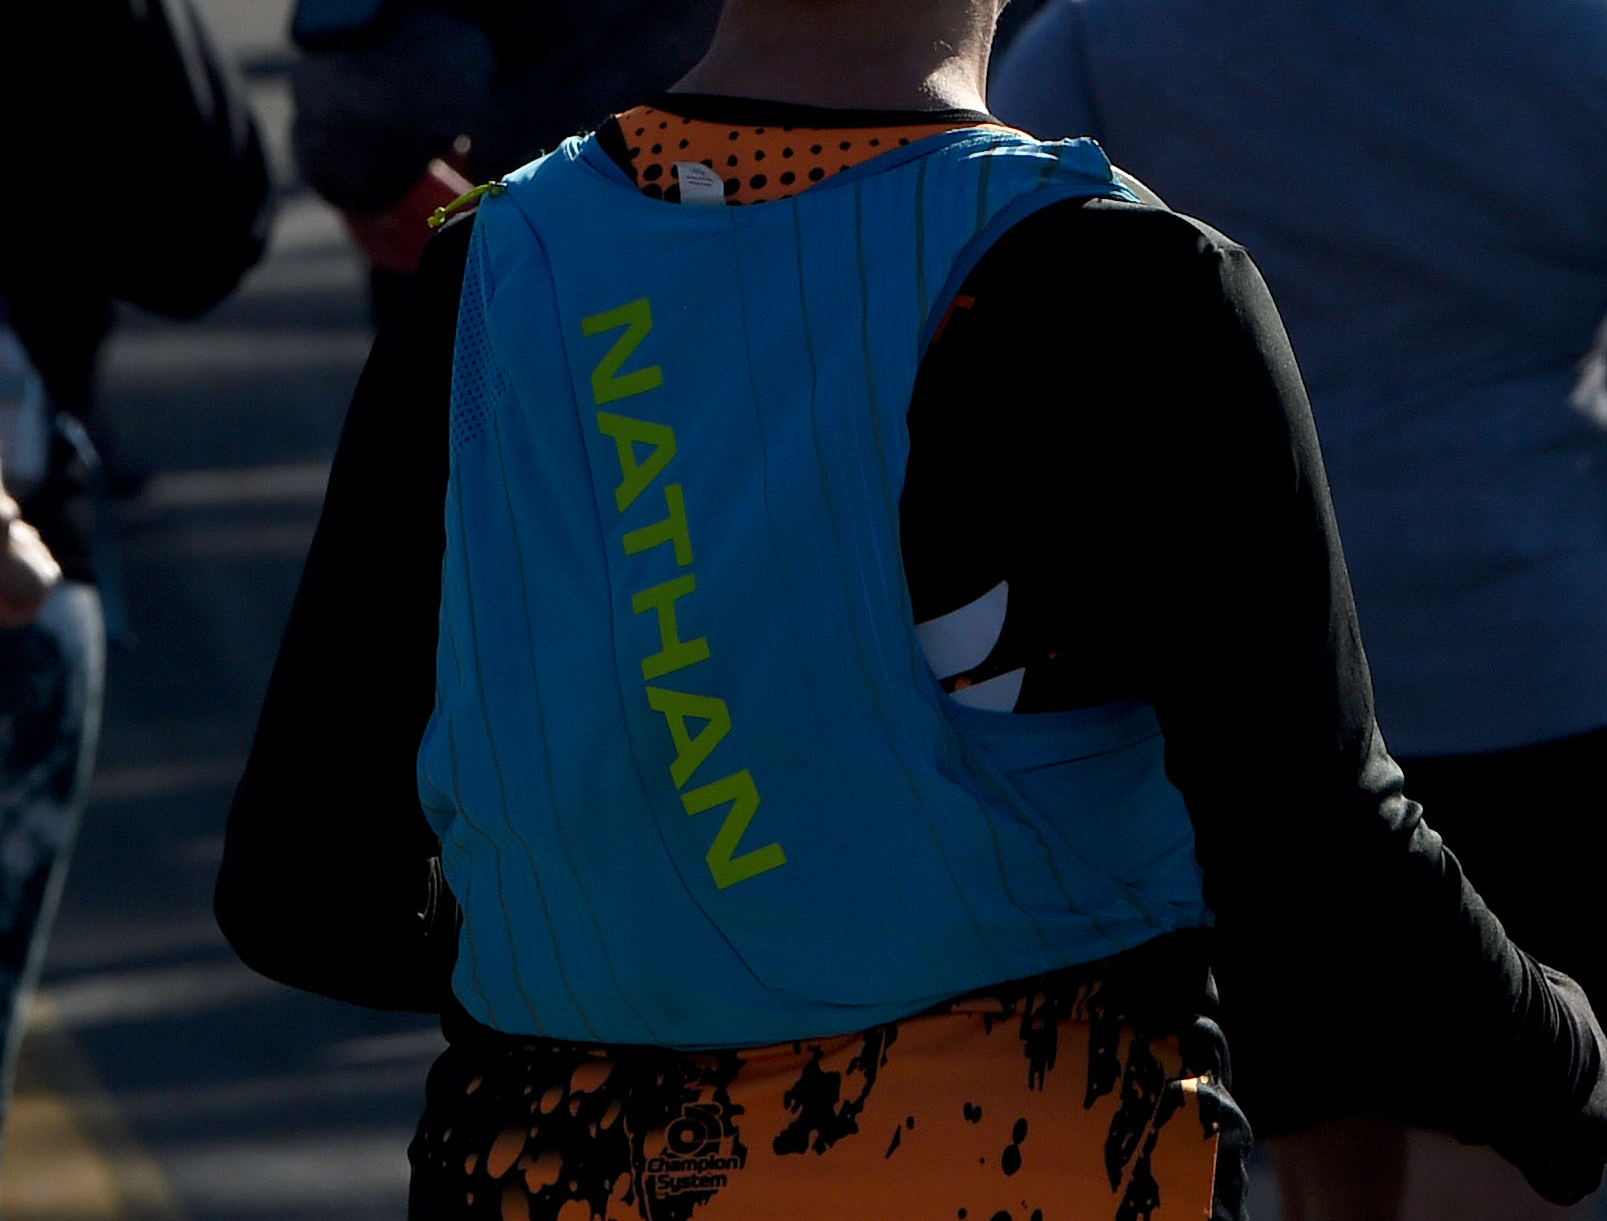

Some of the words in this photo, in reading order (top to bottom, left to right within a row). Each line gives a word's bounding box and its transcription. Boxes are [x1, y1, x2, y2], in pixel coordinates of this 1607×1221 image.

[581, 298, 787, 889] NATHAN
[648, 1155, 738, 1174] Champion
[657, 1173, 727, 1193] System
